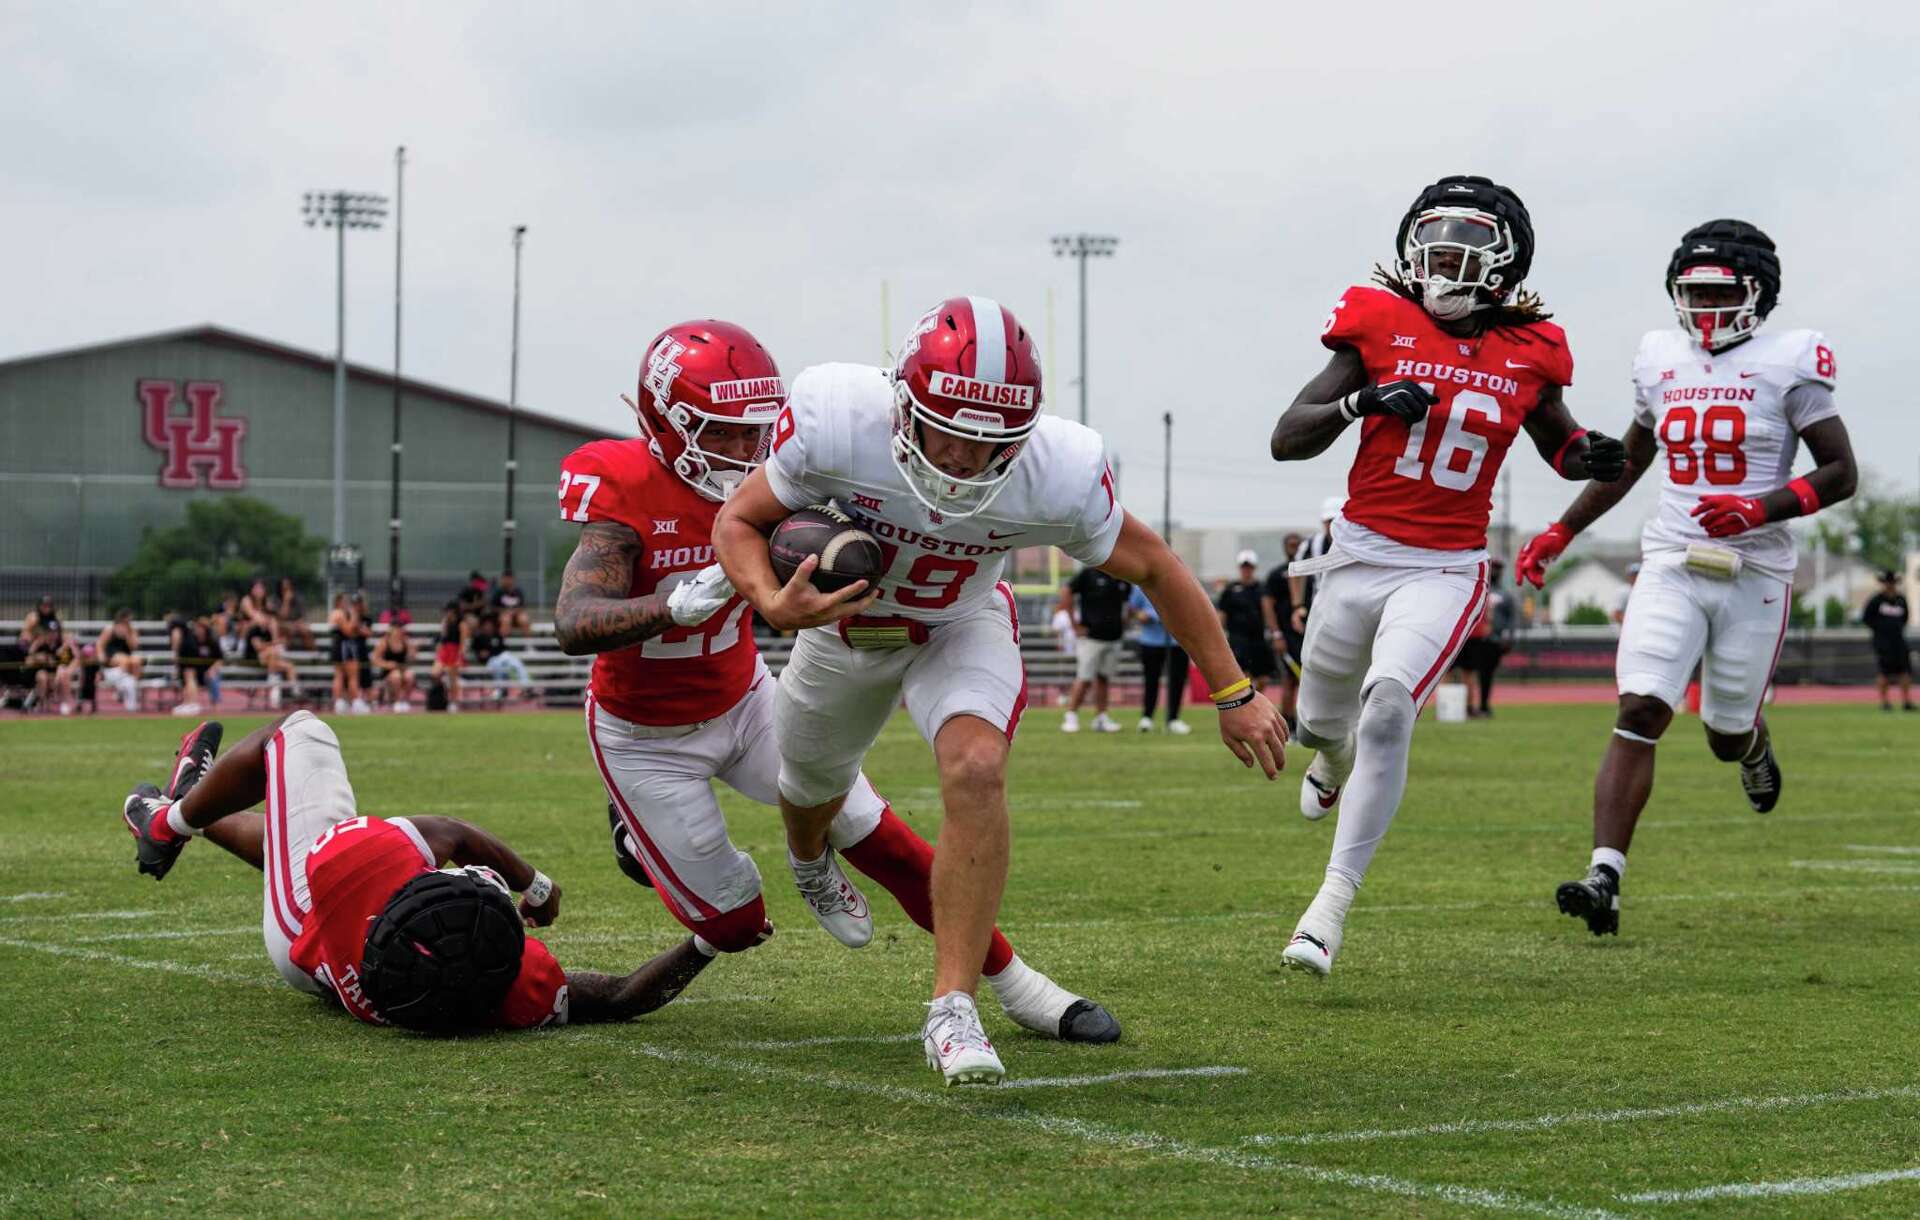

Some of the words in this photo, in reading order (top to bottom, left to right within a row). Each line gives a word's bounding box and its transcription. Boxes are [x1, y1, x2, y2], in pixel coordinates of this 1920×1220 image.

[1394, 359, 1520, 396] HOUSTON
[1816, 344, 1836, 379] 8
[715, 379, 776, 401] WILLIAMS
[940, 376, 1028, 407] CARLISLE
[1663, 387, 1757, 404] HOUSTON
[960, 411, 1002, 424] HOUSTON
[1393, 381, 1502, 492] 16
[1660, 405, 1748, 486] 88
[853, 510, 1014, 557] HOUSTON
[650, 545, 719, 569] HOU
